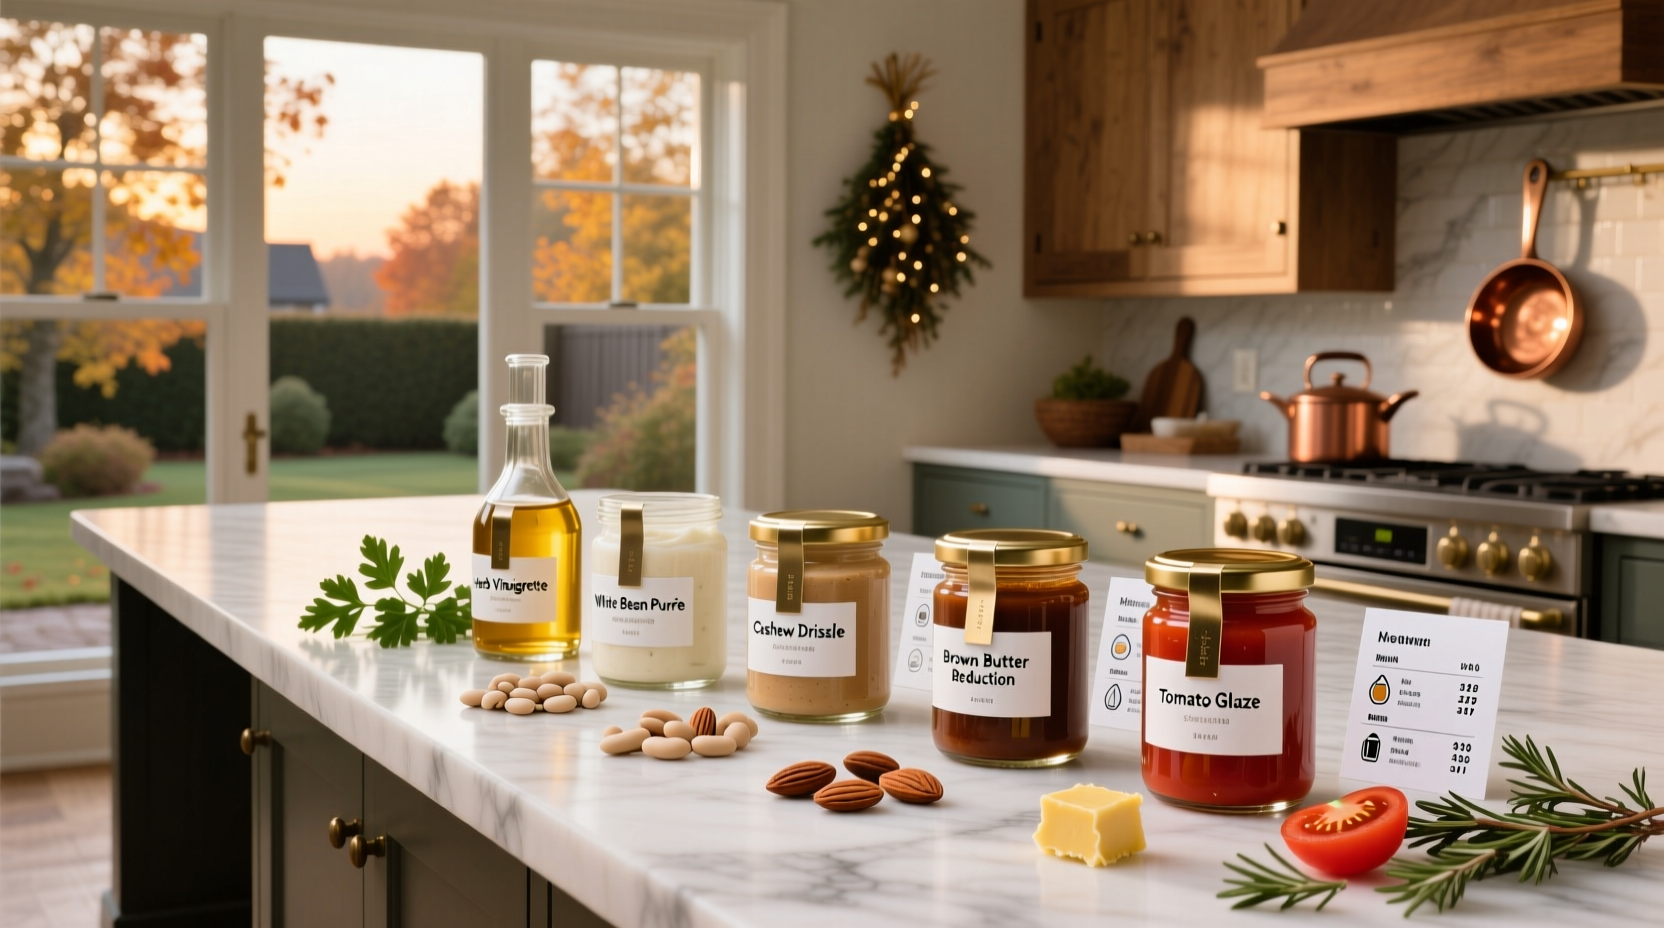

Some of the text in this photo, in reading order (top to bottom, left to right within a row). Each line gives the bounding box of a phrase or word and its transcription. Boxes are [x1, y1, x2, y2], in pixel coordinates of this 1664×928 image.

[944, 649, 978, 667] Brown
[983, 653, 1029, 668] Butter
[952, 669, 1015, 686] Reduction
[1159, 688, 1211, 708] Tomato
[1215, 692, 1261, 709] Glaze
